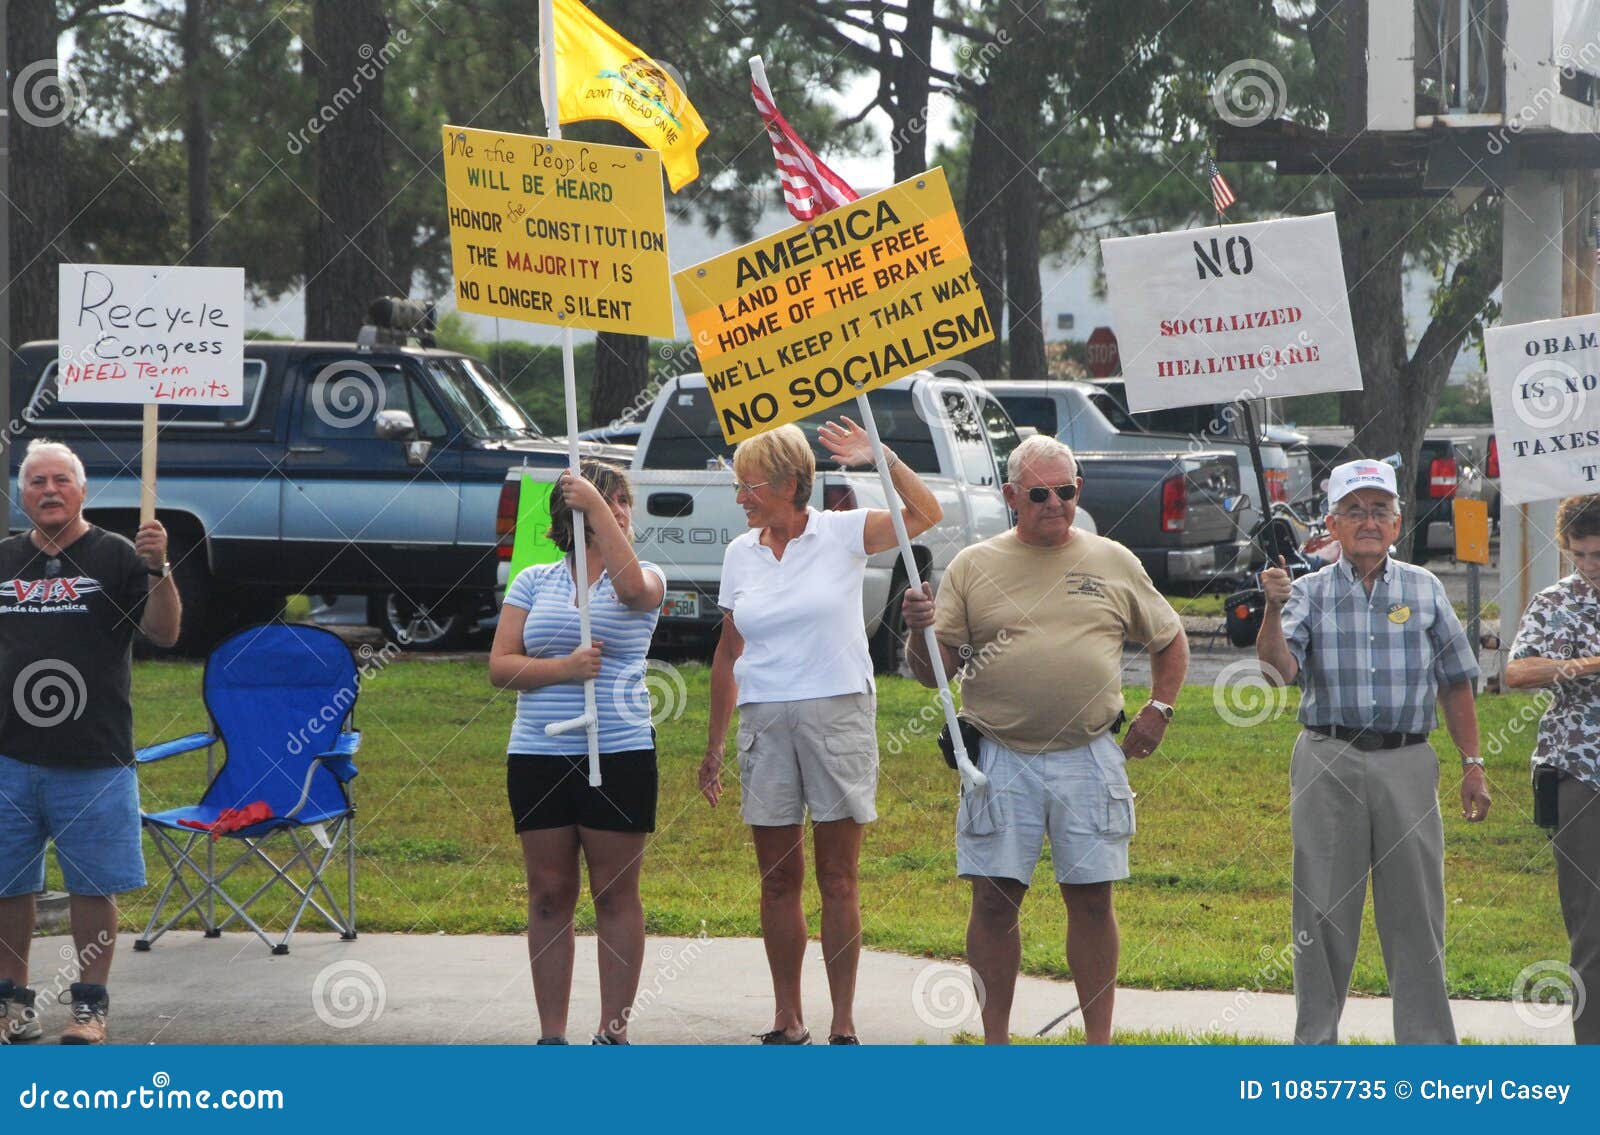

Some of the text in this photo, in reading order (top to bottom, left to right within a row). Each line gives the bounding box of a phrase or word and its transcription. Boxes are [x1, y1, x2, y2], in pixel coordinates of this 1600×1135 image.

[585, 88, 678, 146] DONT TREAD ON ME
[448, 132, 598, 177] We the People
[467, 167, 613, 203] WILL BE HEARD
[450, 201, 665, 252] HONOR the CONSTITUTION
[735, 200, 901, 289] AMERICA
[466, 244, 633, 283] THE MAJORITY IS
[718, 223, 929, 323] LAND OF THE FREE
[1192, 235, 1254, 280] NO
[77, 270, 229, 334] Recycle
[459, 280, 632, 321] NO LONGER SILENT
[717, 246, 945, 353] HOME OF THE BRAVE
[1159, 306, 1303, 337] SOCIALIZED
[94, 335, 223, 362] Congress
[706, 358, 775, 394] WE'LL
[776, 331, 834, 369] KEEP
[840, 317, 862, 343] IT
[869, 292, 923, 330] THAT
[1088, 344, 1117, 364] STOP
[1157, 345, 1320, 377] HEALTHCARE
[65, 362, 189, 386] NEED Term
[153, 379, 230, 400] Limits
[721, 306, 990, 436] NO SOCIALISM
[1519, 374, 1600, 400] IS NO
[1513, 430, 1600, 458] TAXES
[13, 576, 81, 603] VTX
[28, 605, 39, 613] in
[41, 603, 88, 613] America
